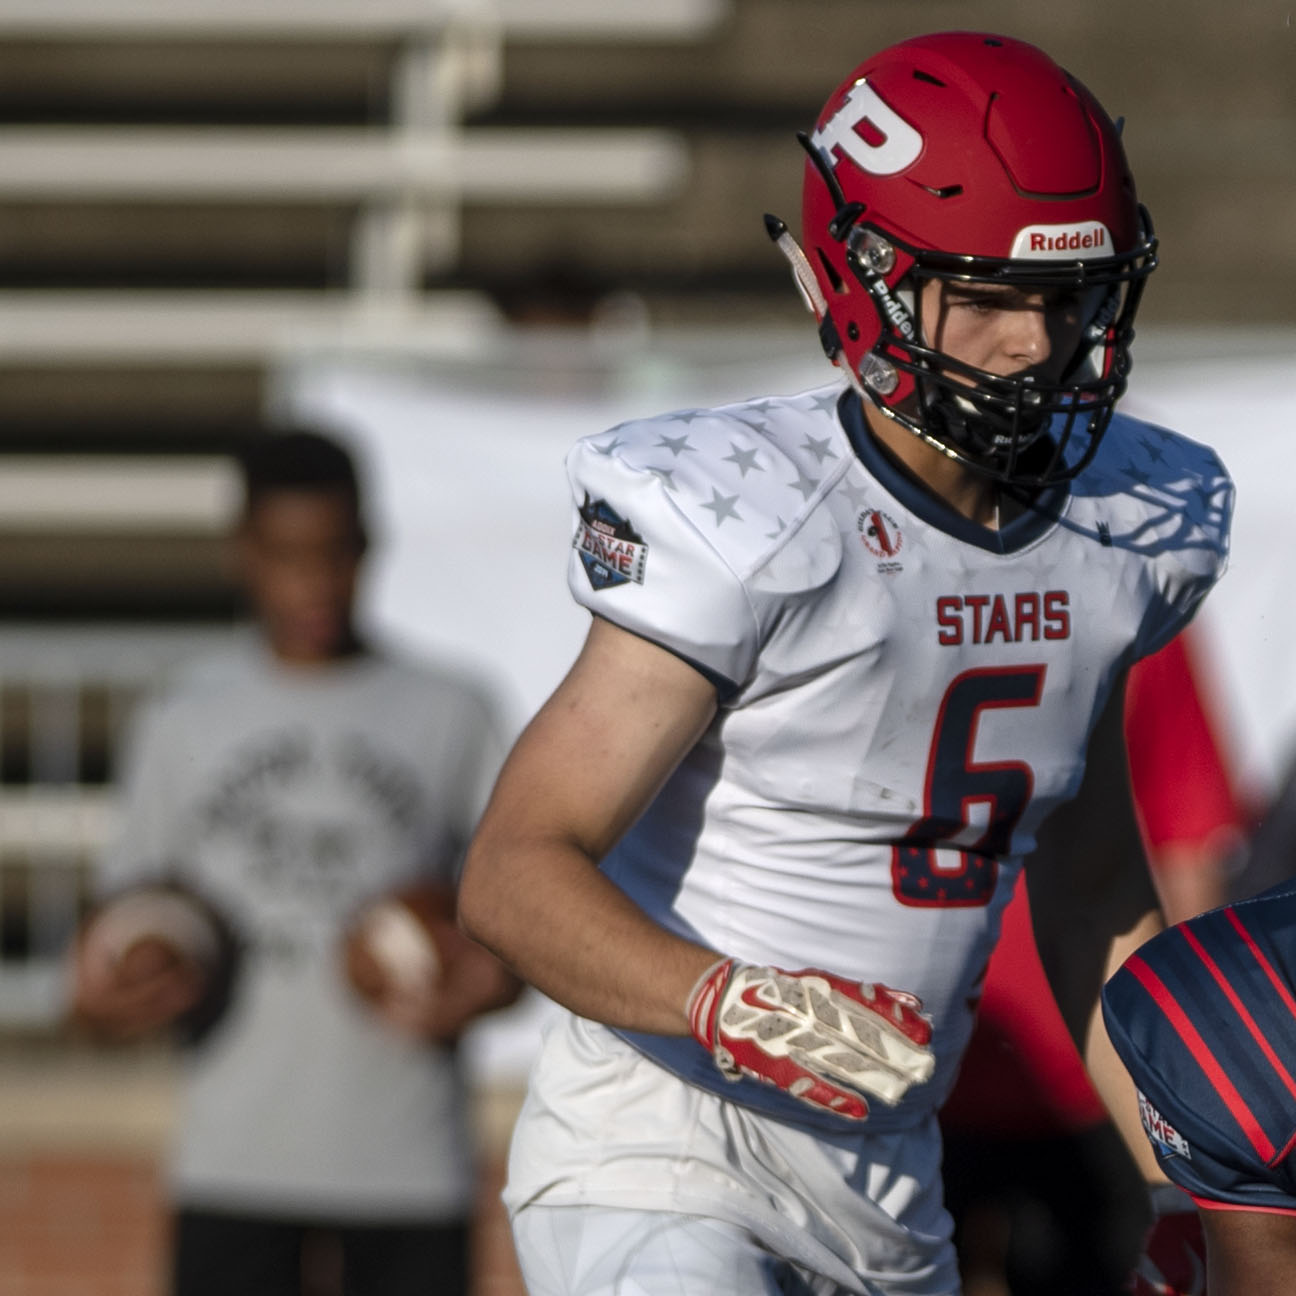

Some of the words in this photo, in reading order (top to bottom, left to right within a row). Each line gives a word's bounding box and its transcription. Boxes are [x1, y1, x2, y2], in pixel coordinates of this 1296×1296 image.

[811, 77, 924, 175] P
[1029, 227, 1105, 252] Riddell
[936, 590, 1071, 646] STARS
[890, 663, 1048, 908] 6
